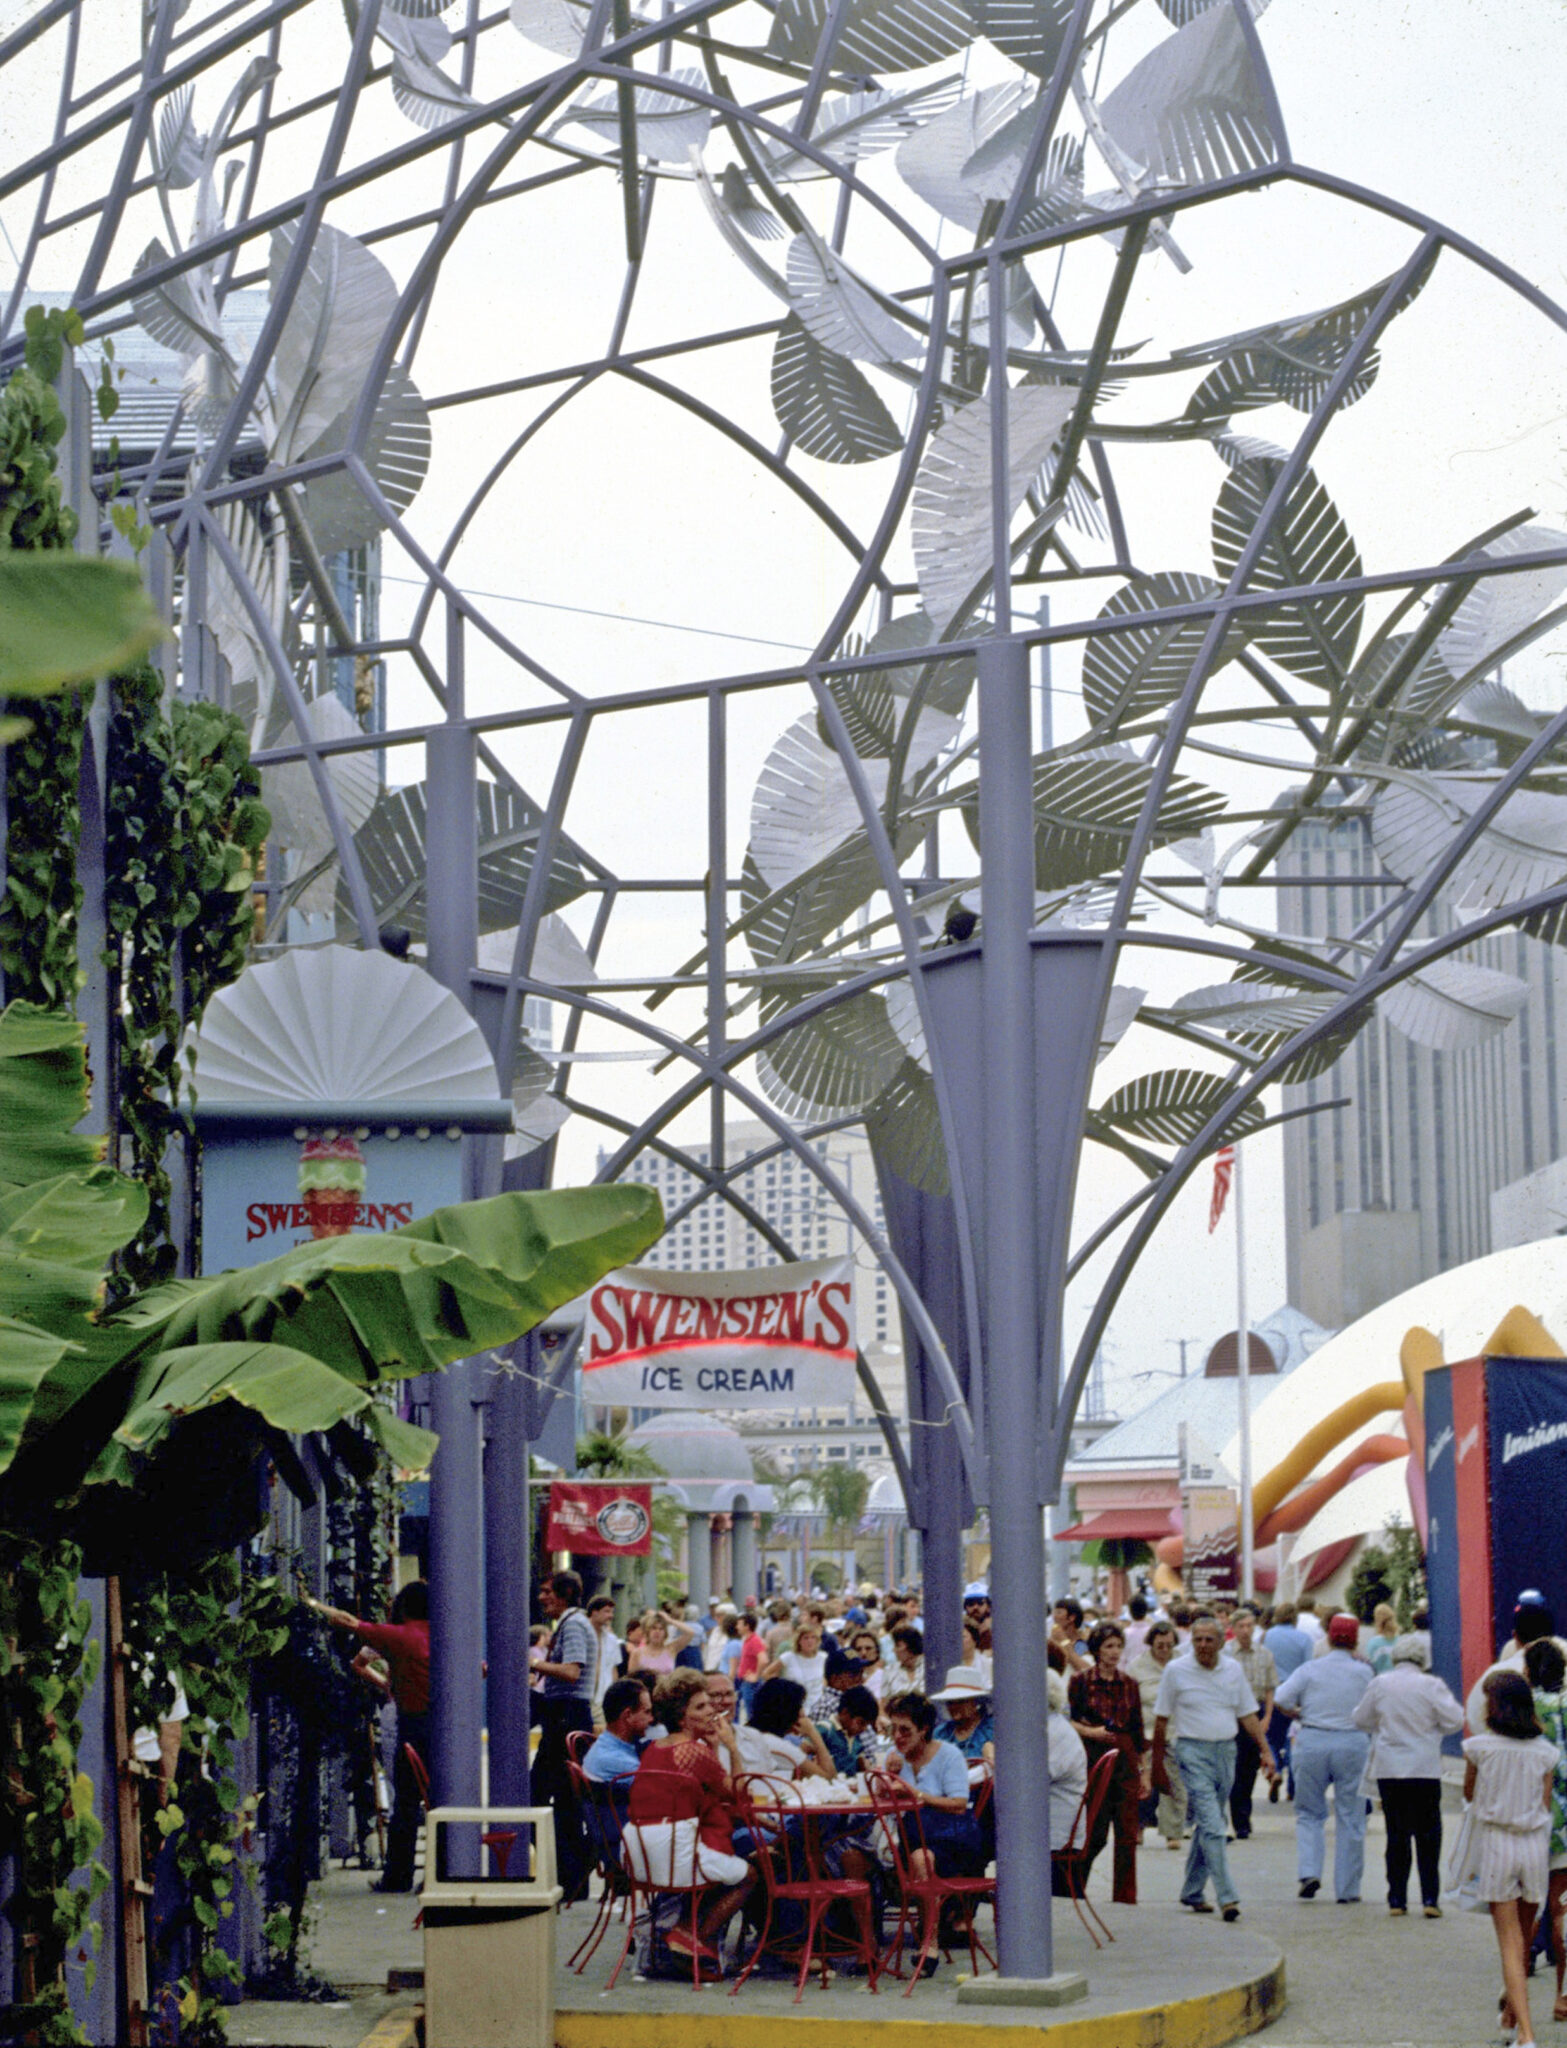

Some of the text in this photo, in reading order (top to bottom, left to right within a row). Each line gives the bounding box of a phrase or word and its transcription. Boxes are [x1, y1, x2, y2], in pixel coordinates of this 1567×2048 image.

[246, 1201, 413, 1242] SWENSEN'S
[590, 1279, 851, 1359] SWENSEN'S
[641, 1366, 795, 1392] ICE CREAM
